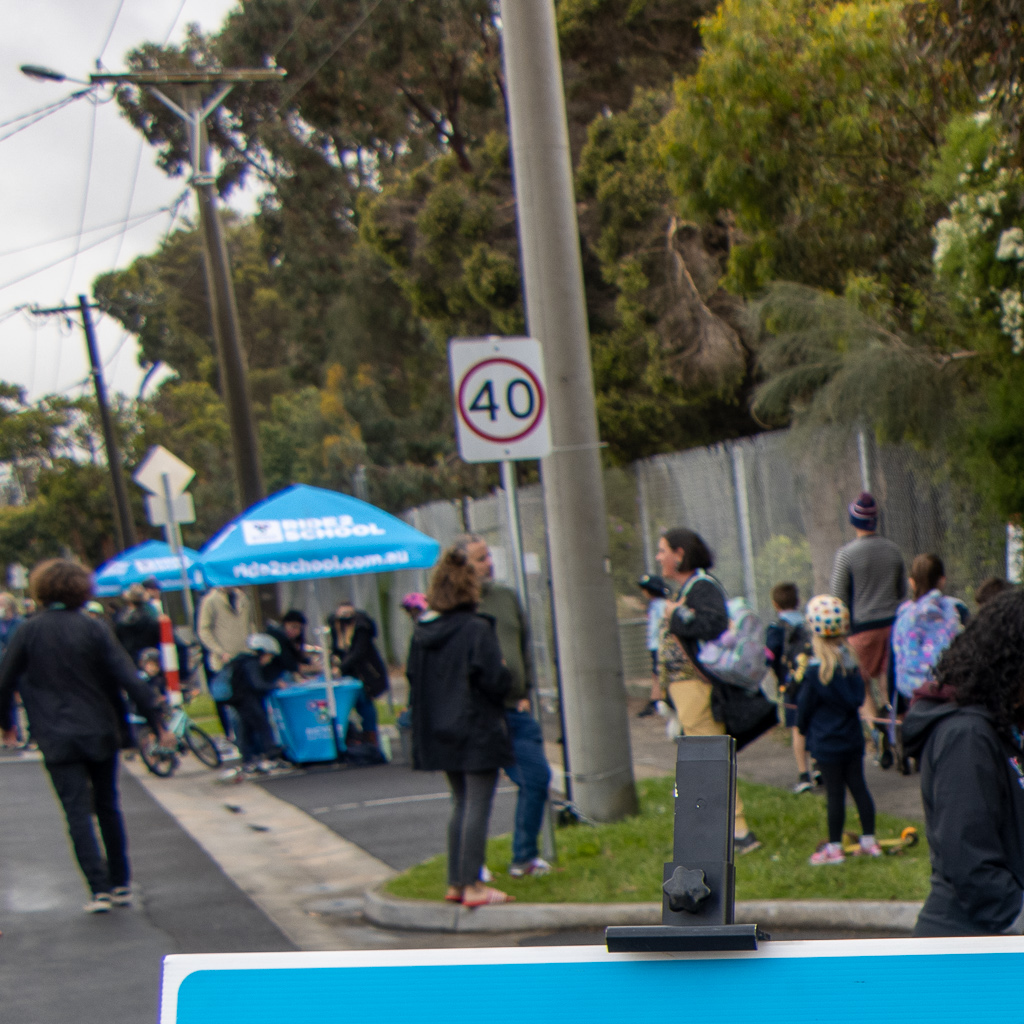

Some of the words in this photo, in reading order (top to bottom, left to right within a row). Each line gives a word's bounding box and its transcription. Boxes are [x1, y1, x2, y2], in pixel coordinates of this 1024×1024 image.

[468, 377, 536, 422] 40
[284, 523, 387, 543] SCHOOL
[232, 550, 410, 579] ride2school.com.au
